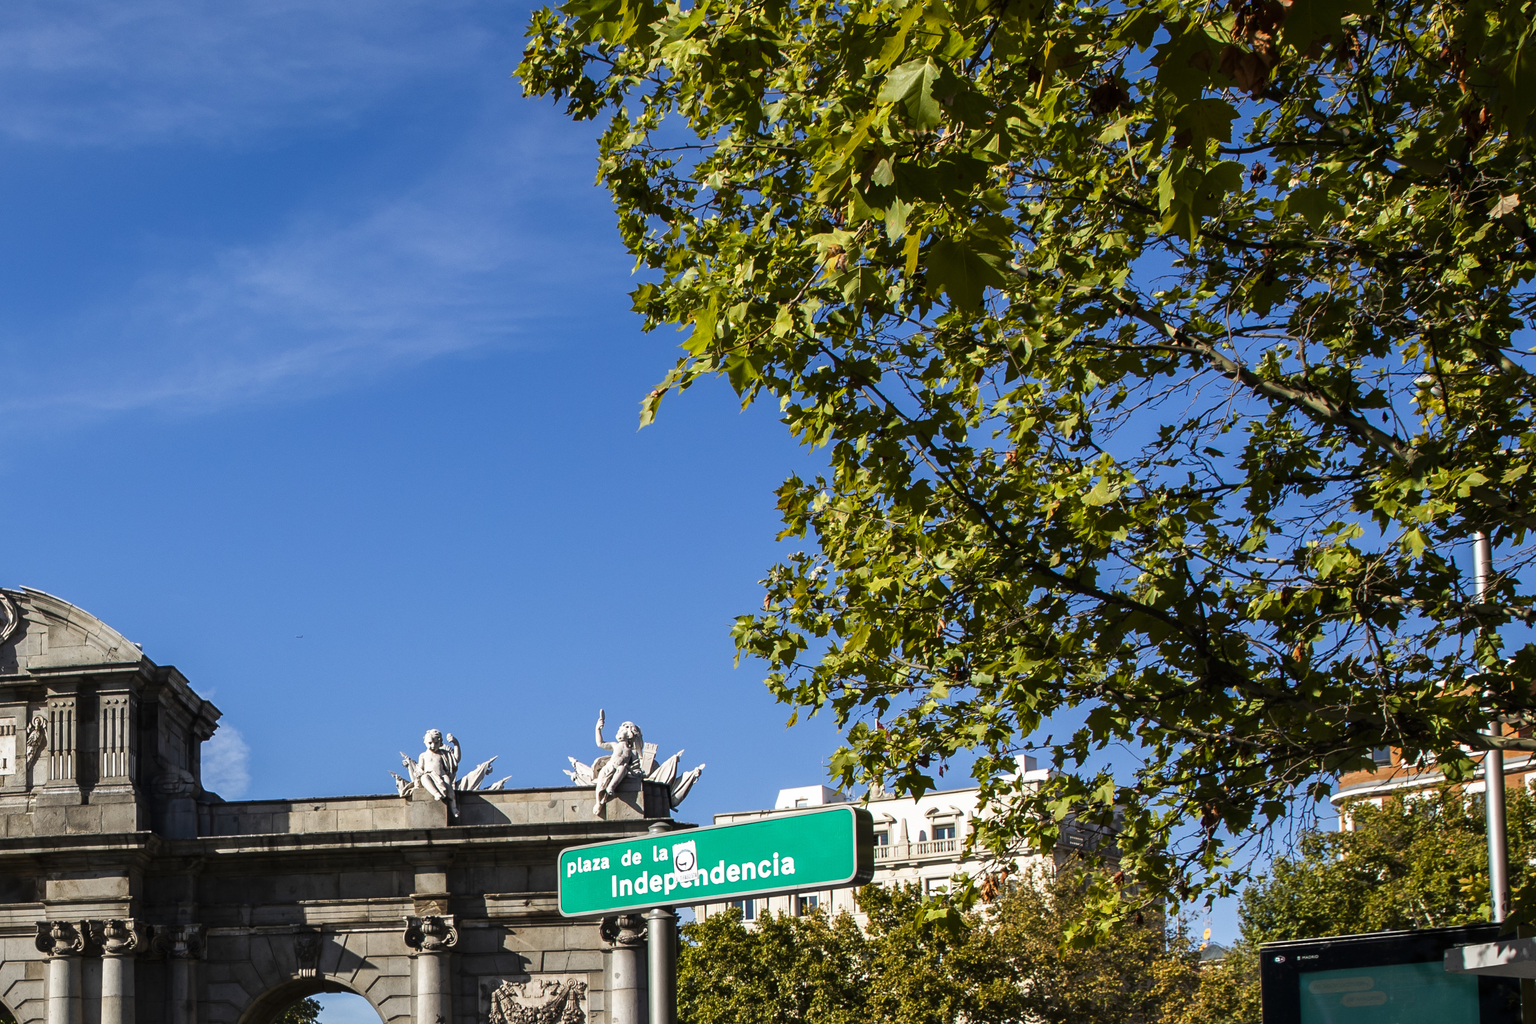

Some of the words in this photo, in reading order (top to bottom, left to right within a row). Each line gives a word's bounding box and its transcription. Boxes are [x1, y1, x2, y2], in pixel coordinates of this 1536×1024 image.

[0, 724, 17, 737] III
[566, 854, 611, 878] plaza
[620, 849, 643, 868] de
[652, 844, 670, 863] la
